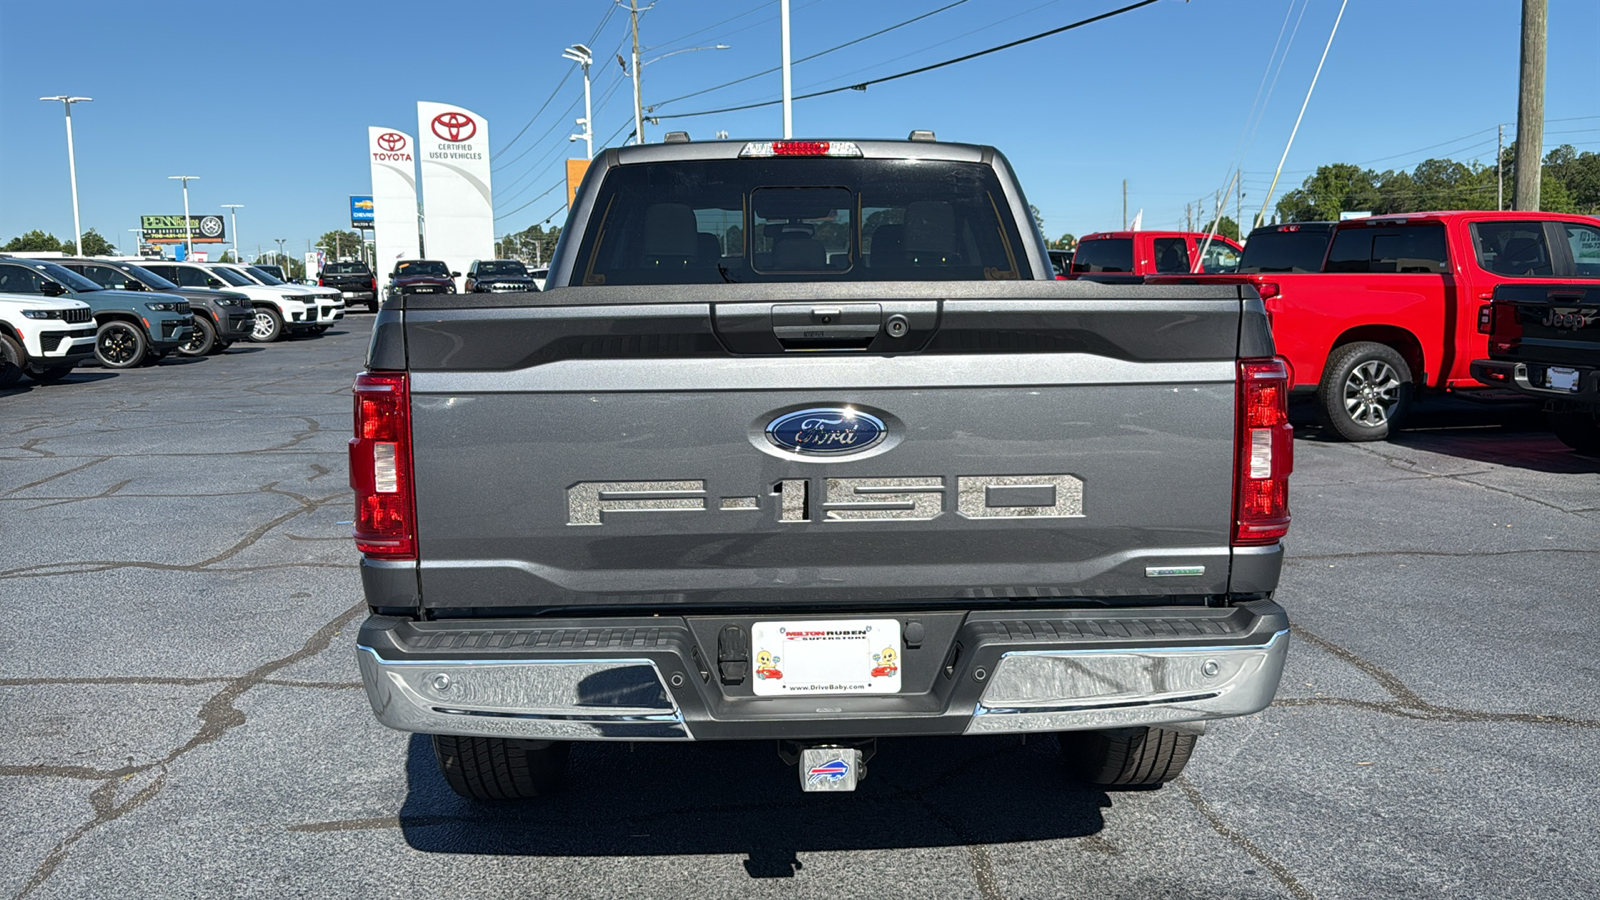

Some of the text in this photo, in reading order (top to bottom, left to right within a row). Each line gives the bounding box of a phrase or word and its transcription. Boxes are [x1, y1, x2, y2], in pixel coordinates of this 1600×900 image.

[438, 143, 473, 151] CERTIFIED
[372, 152, 412, 162] TOYOTA
[429, 151, 482, 160] USED VEHICLES
[143, 216, 177, 228] PENN
[1542, 308, 1585, 332] Jeep
[795, 418, 858, 445] Ford
[565, 474, 1086, 527] F-150
[789, 684, 865, 692] www.DriveBaby.com
